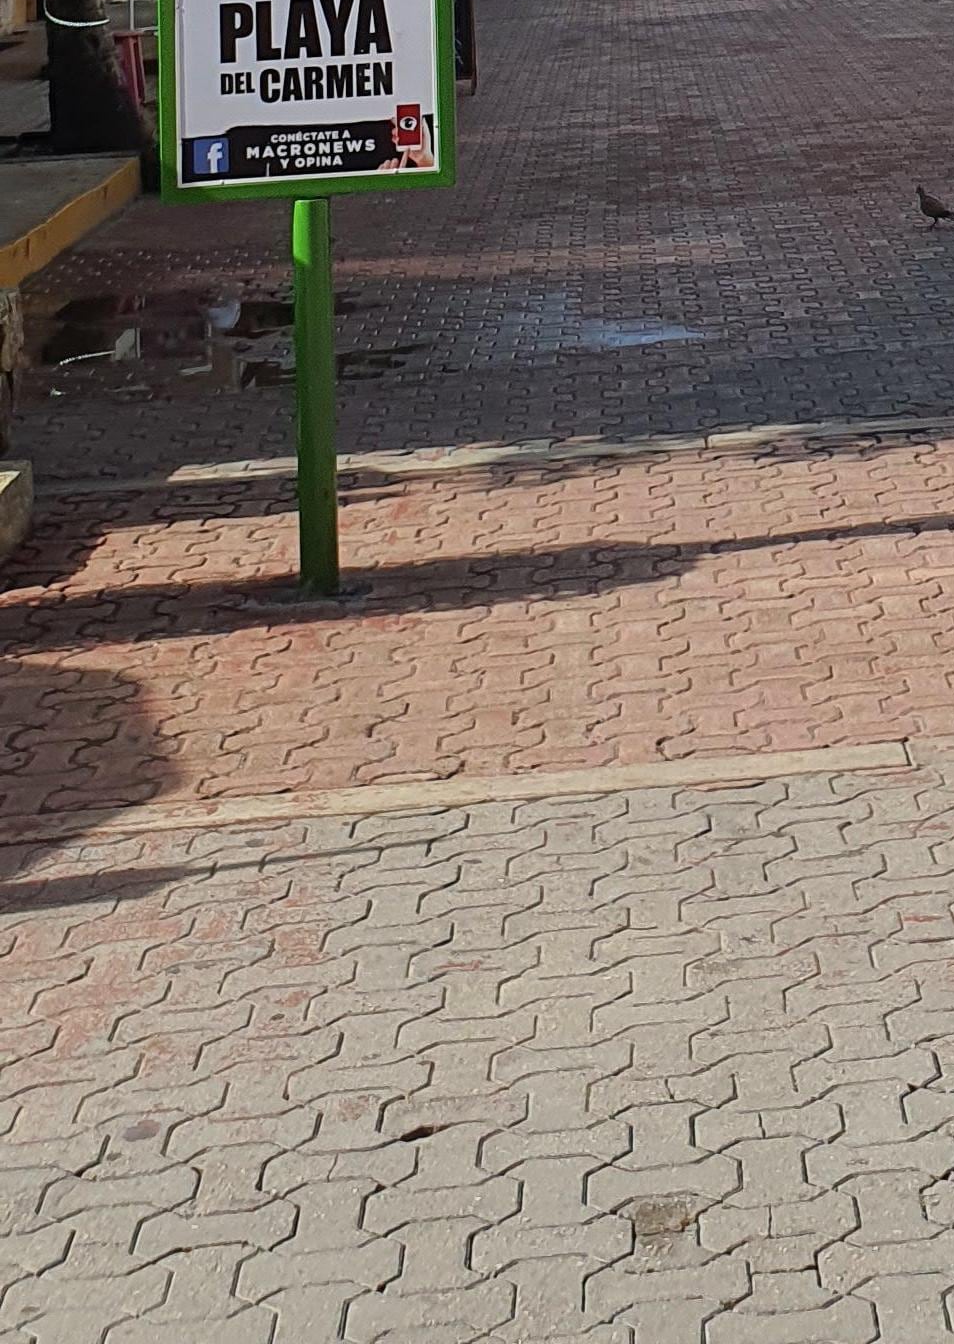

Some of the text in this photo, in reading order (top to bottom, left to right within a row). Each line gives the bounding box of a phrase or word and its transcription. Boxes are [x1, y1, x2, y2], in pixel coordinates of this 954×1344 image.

[220, 62, 394, 103] DEL CARMEN
[271, 130, 351, 144] CONÉCTATE A
[246, 139, 376, 160] MACRONEWS
[280, 156, 343, 170] Y OPINA
